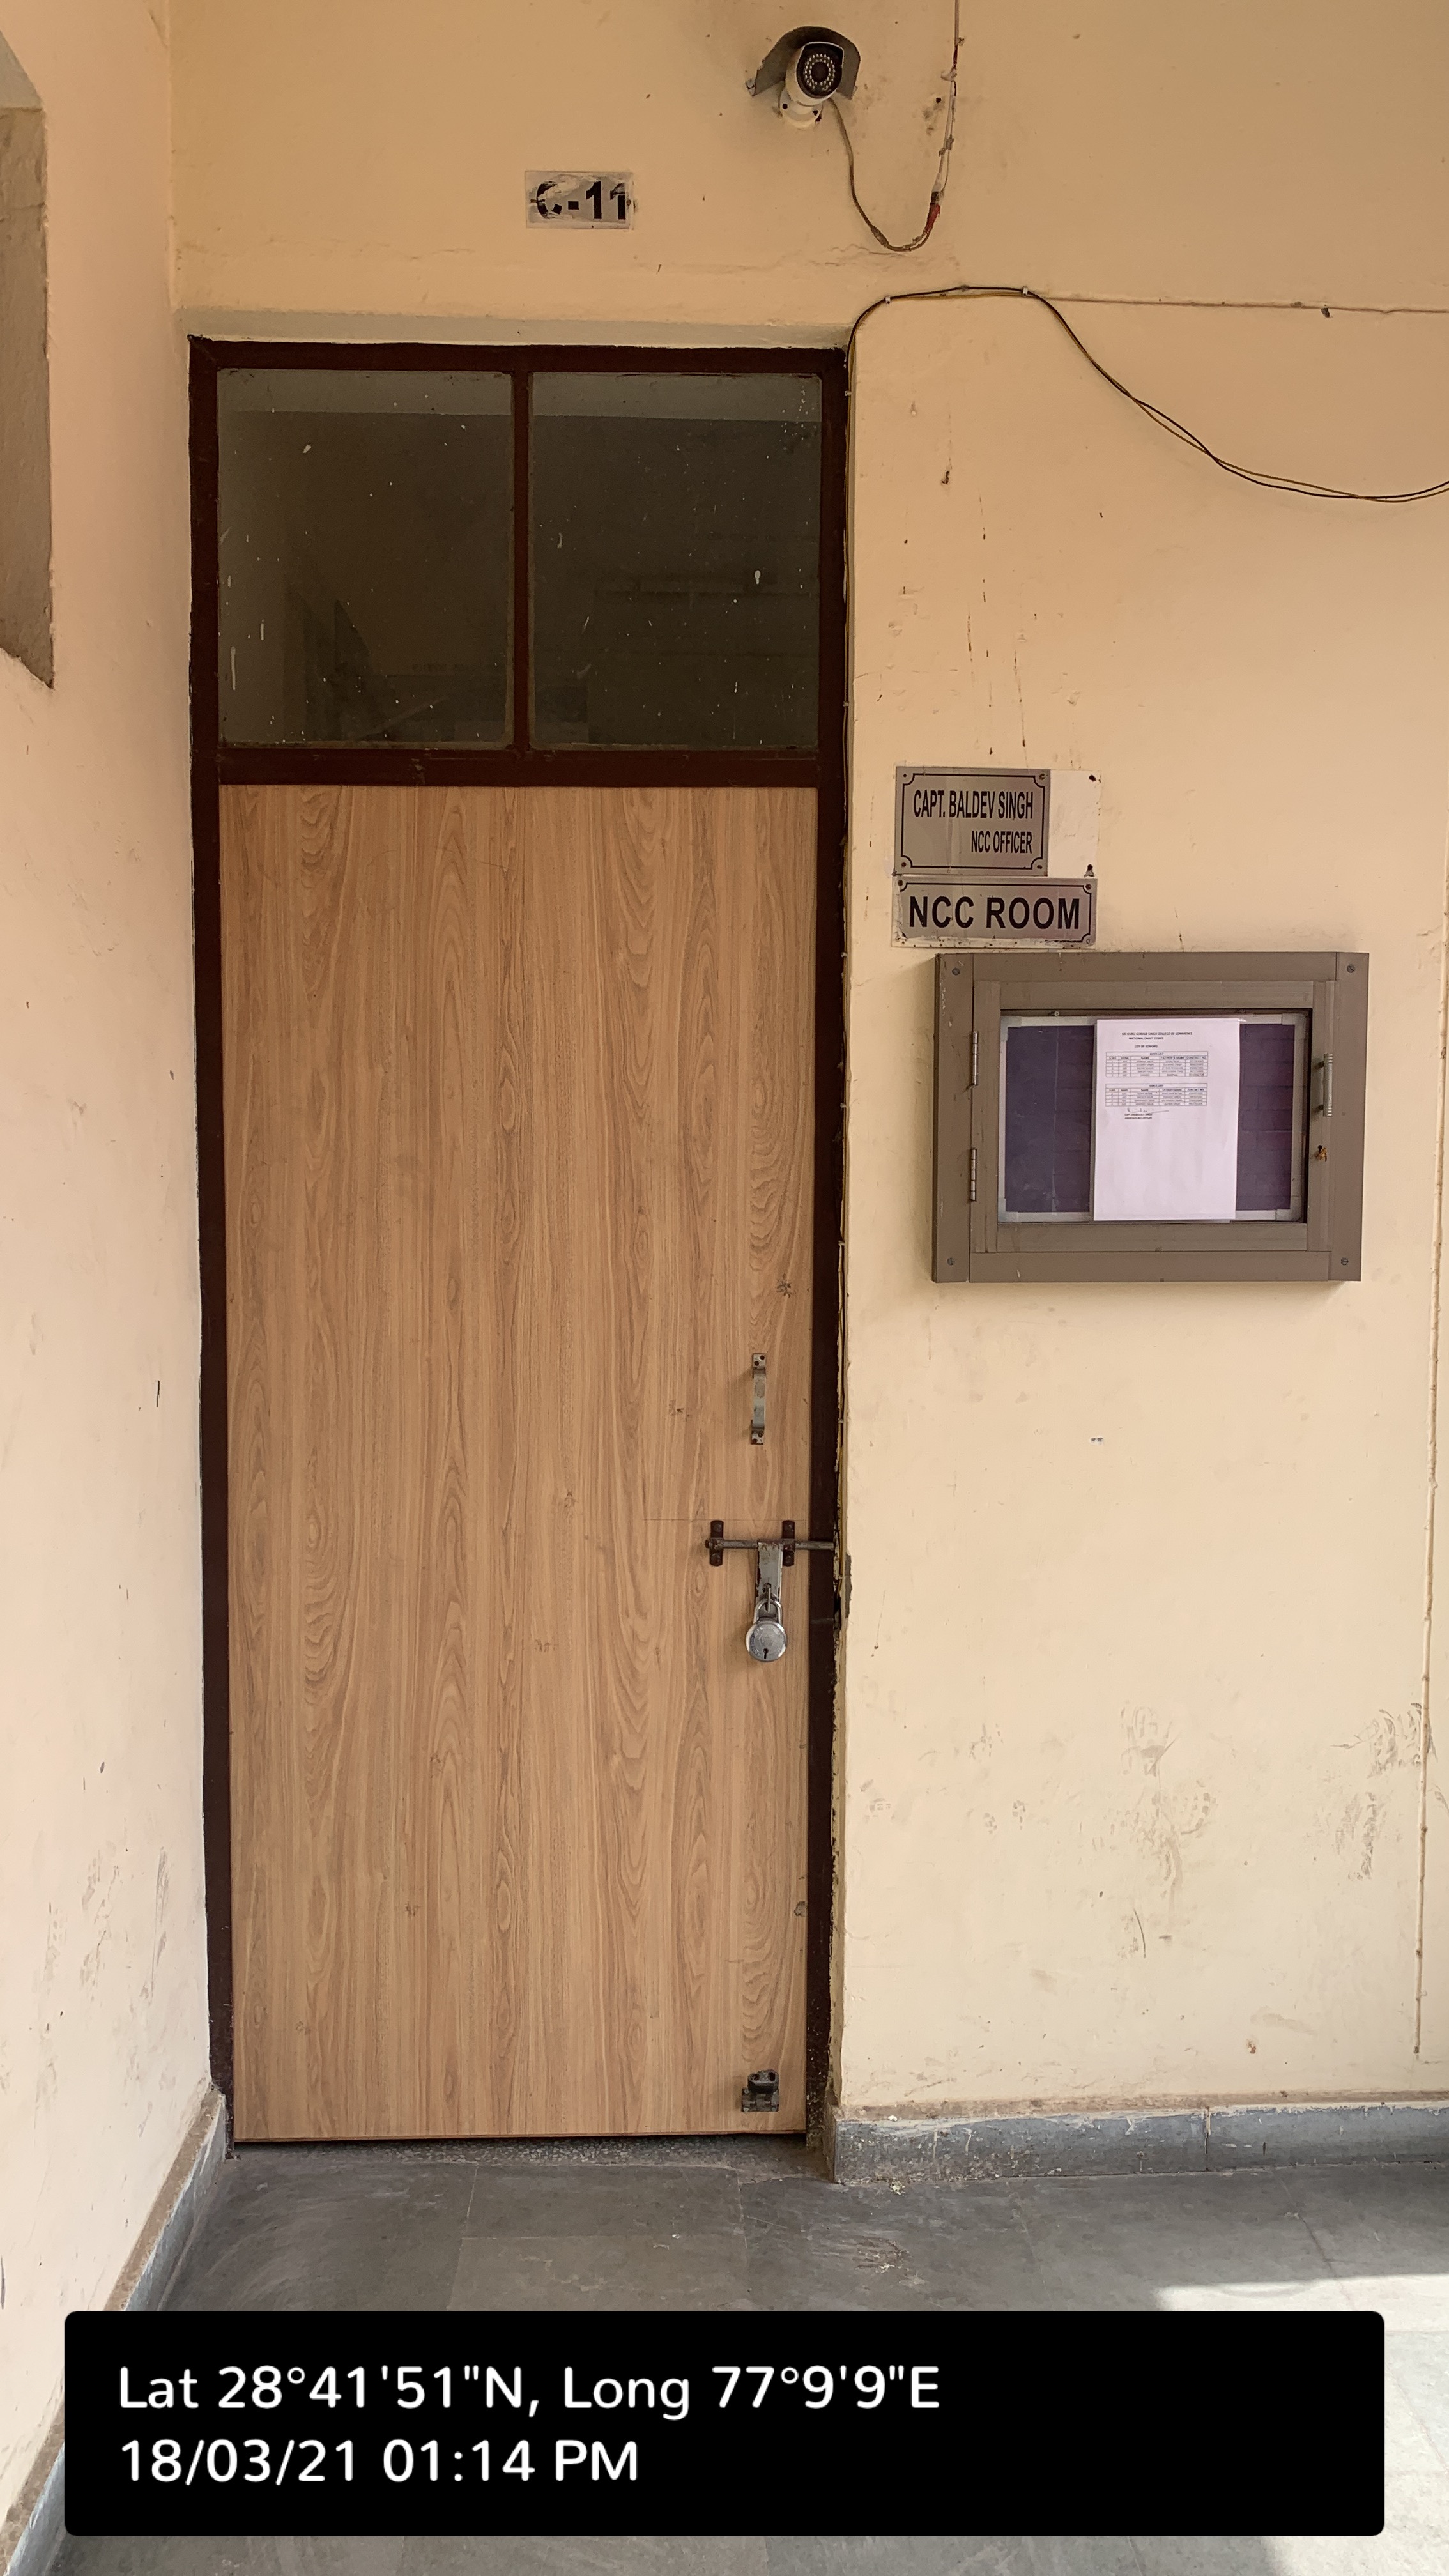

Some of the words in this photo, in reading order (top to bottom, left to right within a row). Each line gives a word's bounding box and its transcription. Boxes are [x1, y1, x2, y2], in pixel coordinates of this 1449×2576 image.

[913, 789, 946, 818] CAPT.
[949, 790, 996, 818] BALDEV
[997, 791, 1034, 819] SINGH
[971, 830, 991, 853] NCC
[993, 831, 1032, 854] OFFICER
[909, 896, 974, 928] NCC
[986, 896, 1080, 930] ROOM
